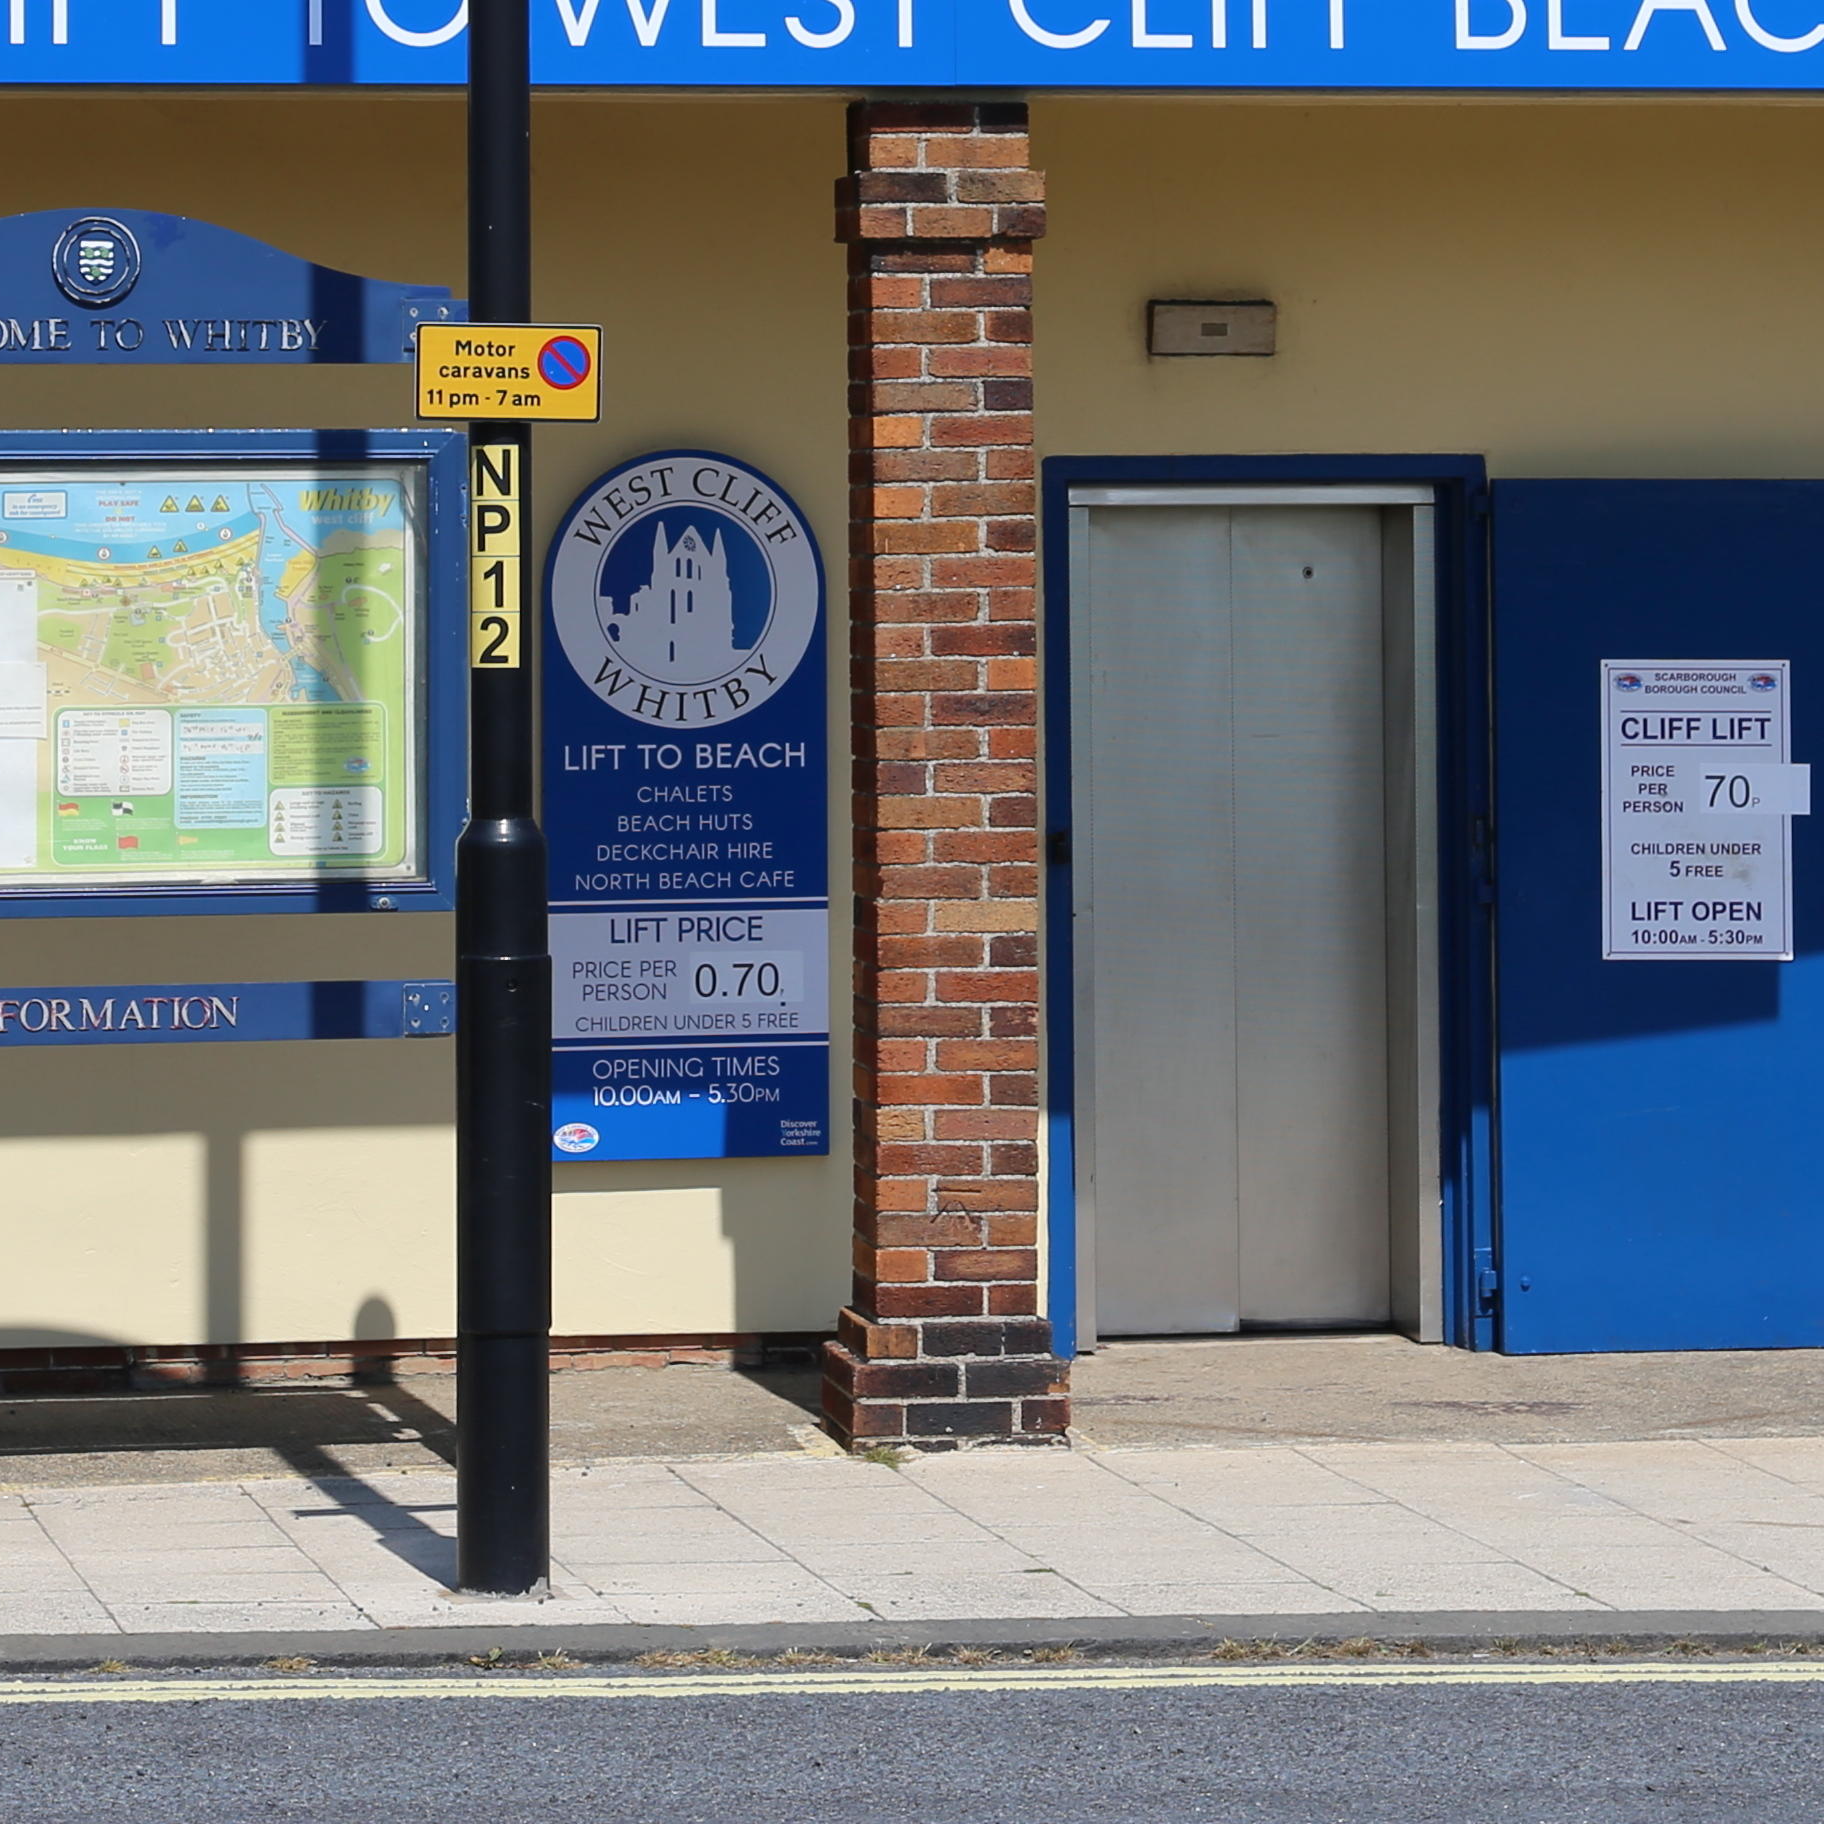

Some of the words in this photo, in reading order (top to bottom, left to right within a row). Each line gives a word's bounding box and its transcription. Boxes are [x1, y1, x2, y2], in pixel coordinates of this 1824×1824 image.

[93, 318, 145, 351] TO
[163, 317, 328, 352] WHITBY
[455, 340, 516, 357] Motor
[439, 362, 530, 379] caravans
[299, 486, 396, 517] Whitby
[573, 467, 674, 549] WEST
[692, 467, 797, 545] CLIFF
[310, 515, 344, 524] west
[1654, 672, 1736, 682] SCARBOROUGH
[593, 653, 778, 721] WHITBY
[1644, 684, 1698, 694] BOROUGH
[1700, 684, 1747, 694] COUNCIL
[1621, 717, 1701, 740] CLIFF
[1712, 717, 1771, 740] LIFT
[564, 745, 626, 770] LIFT
[637, 744, 683, 769] TO
[695, 742, 806, 768] BEACH
[1631, 765, 1675, 777] PRICE
[636, 785, 734, 803] CHALETS
[1638, 783, 1668, 795] PER
[1622, 801, 1684, 813] PERSON
[617, 815, 691, 832] BEACH
[699, 813, 753, 831] HUTS
[597, 843, 719, 861] DECKCHAIR
[728, 842, 774, 859] HIRE
[1630, 843, 1705, 855] CHILDREN
[1710, 843, 1761, 855] UNDER
[1669, 860, 1681, 877] 5
[1686, 866, 1724, 877] FREE
[575, 873, 651, 891] NORTH
[659, 871, 731, 889] BEACH
[739, 870, 795, 888] CAFE
[1631, 901, 1684, 921] LIFT
[1692, 901, 1763, 921] OPEN
[610, 918, 668, 944] LIFT
[678, 916, 763, 942] PRICE
[1631, 929, 1698, 945] 10:00AM
[1708, 929, 1763, 945] 5:30PM
[572, 961, 632, 979] PRICE
[640, 960, 678, 978] PER
[582, 983, 667, 1002] PERSON
[575, 1015, 668, 1032] CHILDREN
[674, 1013, 736, 1031] UNDER
[741, 1014, 752, 1029] 5
[758, 1012, 799, 1028] FREE
[592, 1057, 704, 1080] OPENING
[711, 1056, 781, 1077] TIMES
[592, 1085, 681, 1106] 10.00AM
[707, 1082, 781, 1104] 5.30PM
[780, 1120, 818, 1128] Discover
